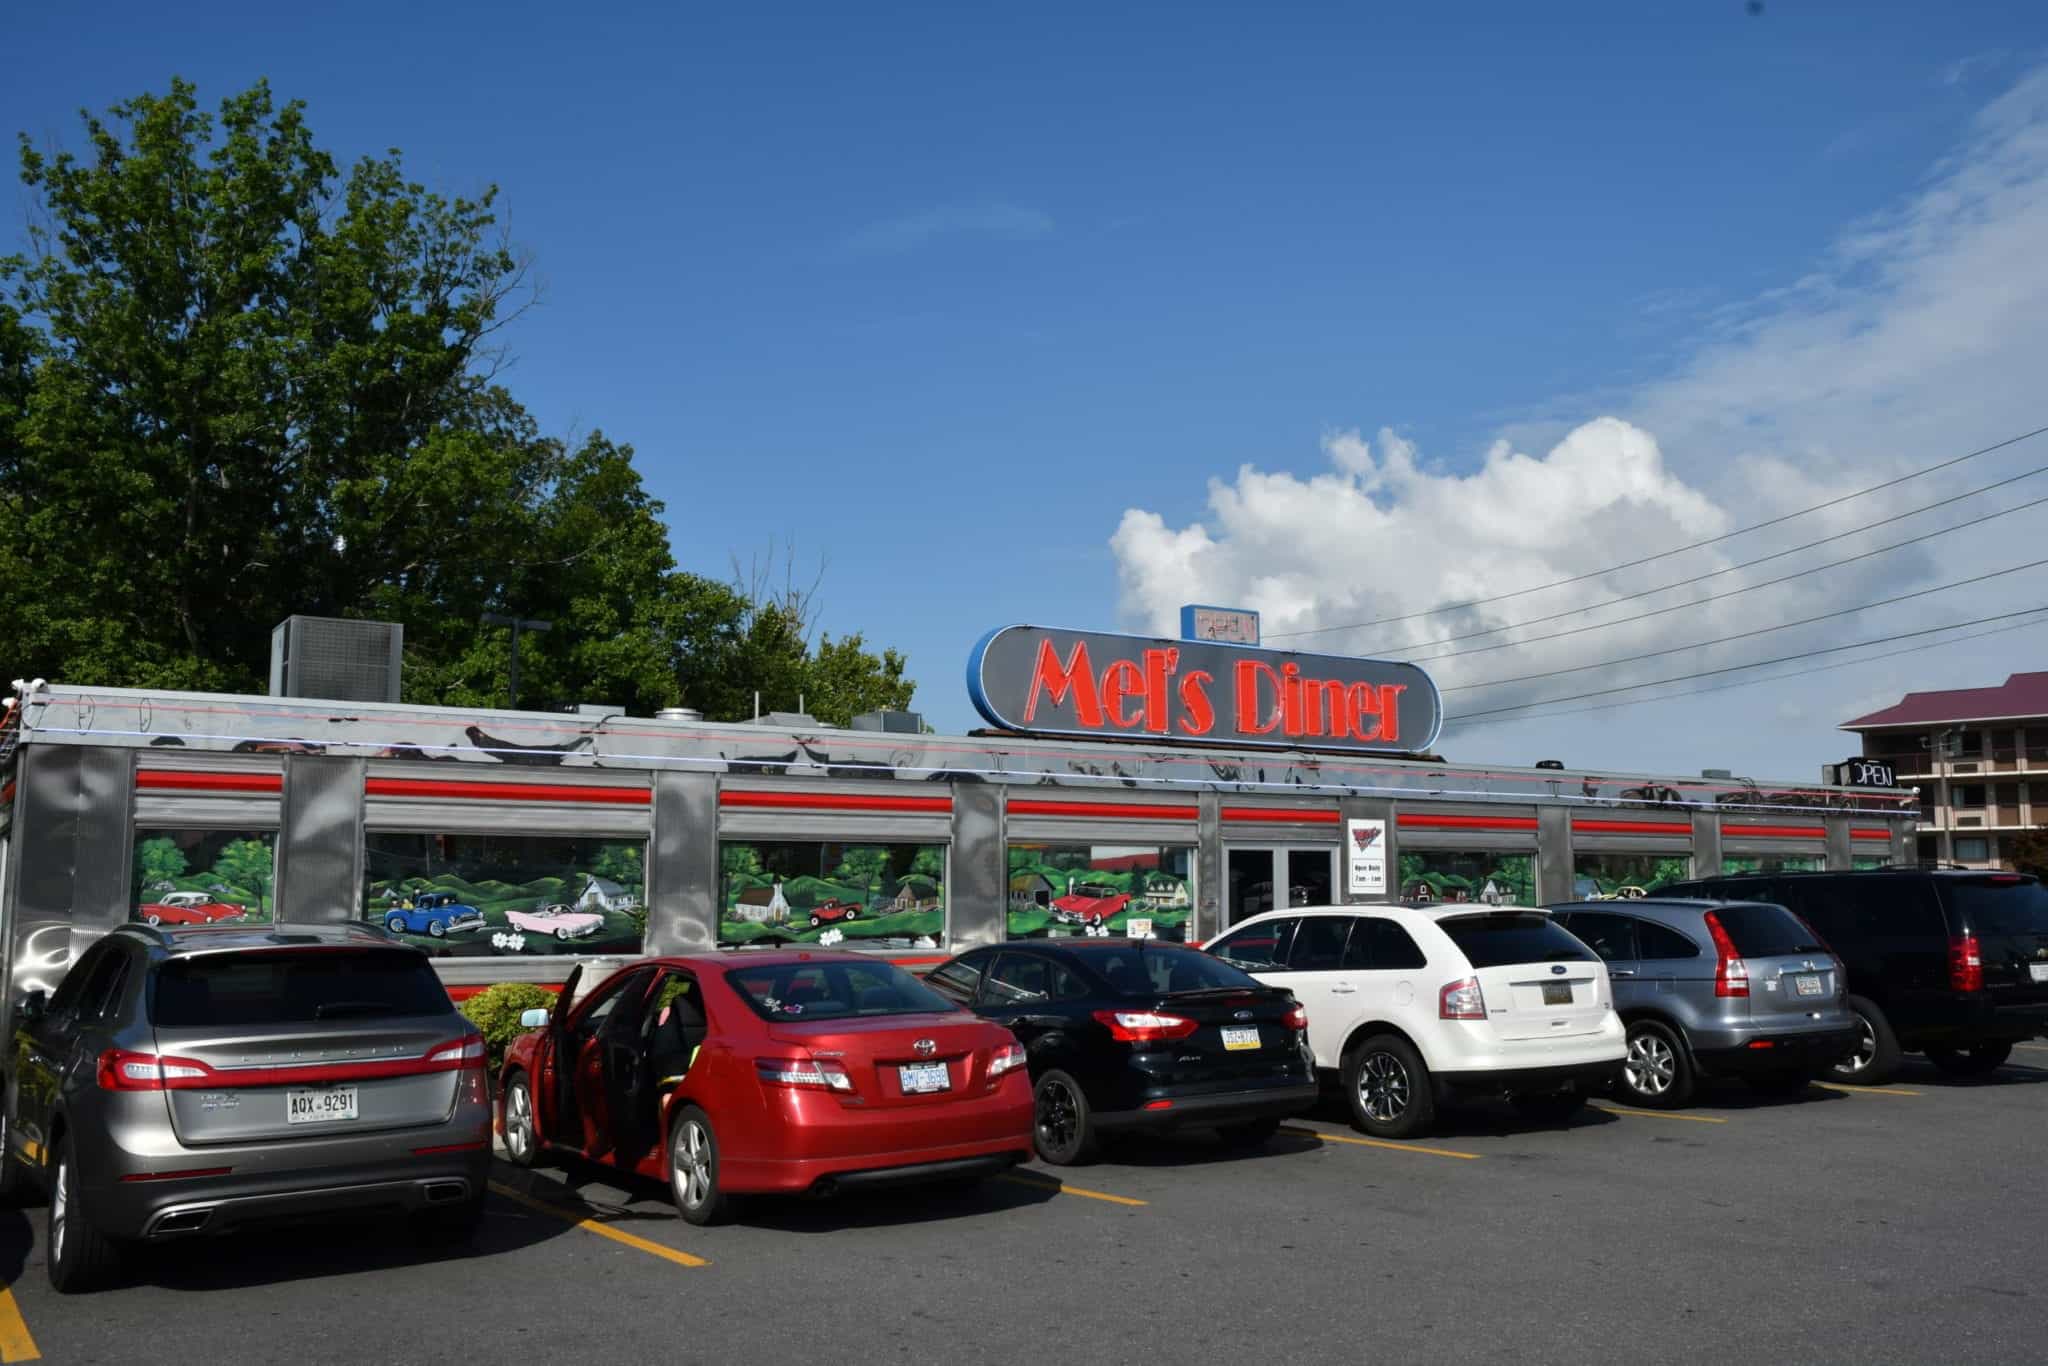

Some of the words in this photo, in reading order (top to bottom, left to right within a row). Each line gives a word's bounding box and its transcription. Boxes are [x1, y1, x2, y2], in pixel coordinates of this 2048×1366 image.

[1023, 638, 1215, 736] Mel's
[1234, 659, 1408, 742] Diner
[324, 1093, 353, 1112] 9291
